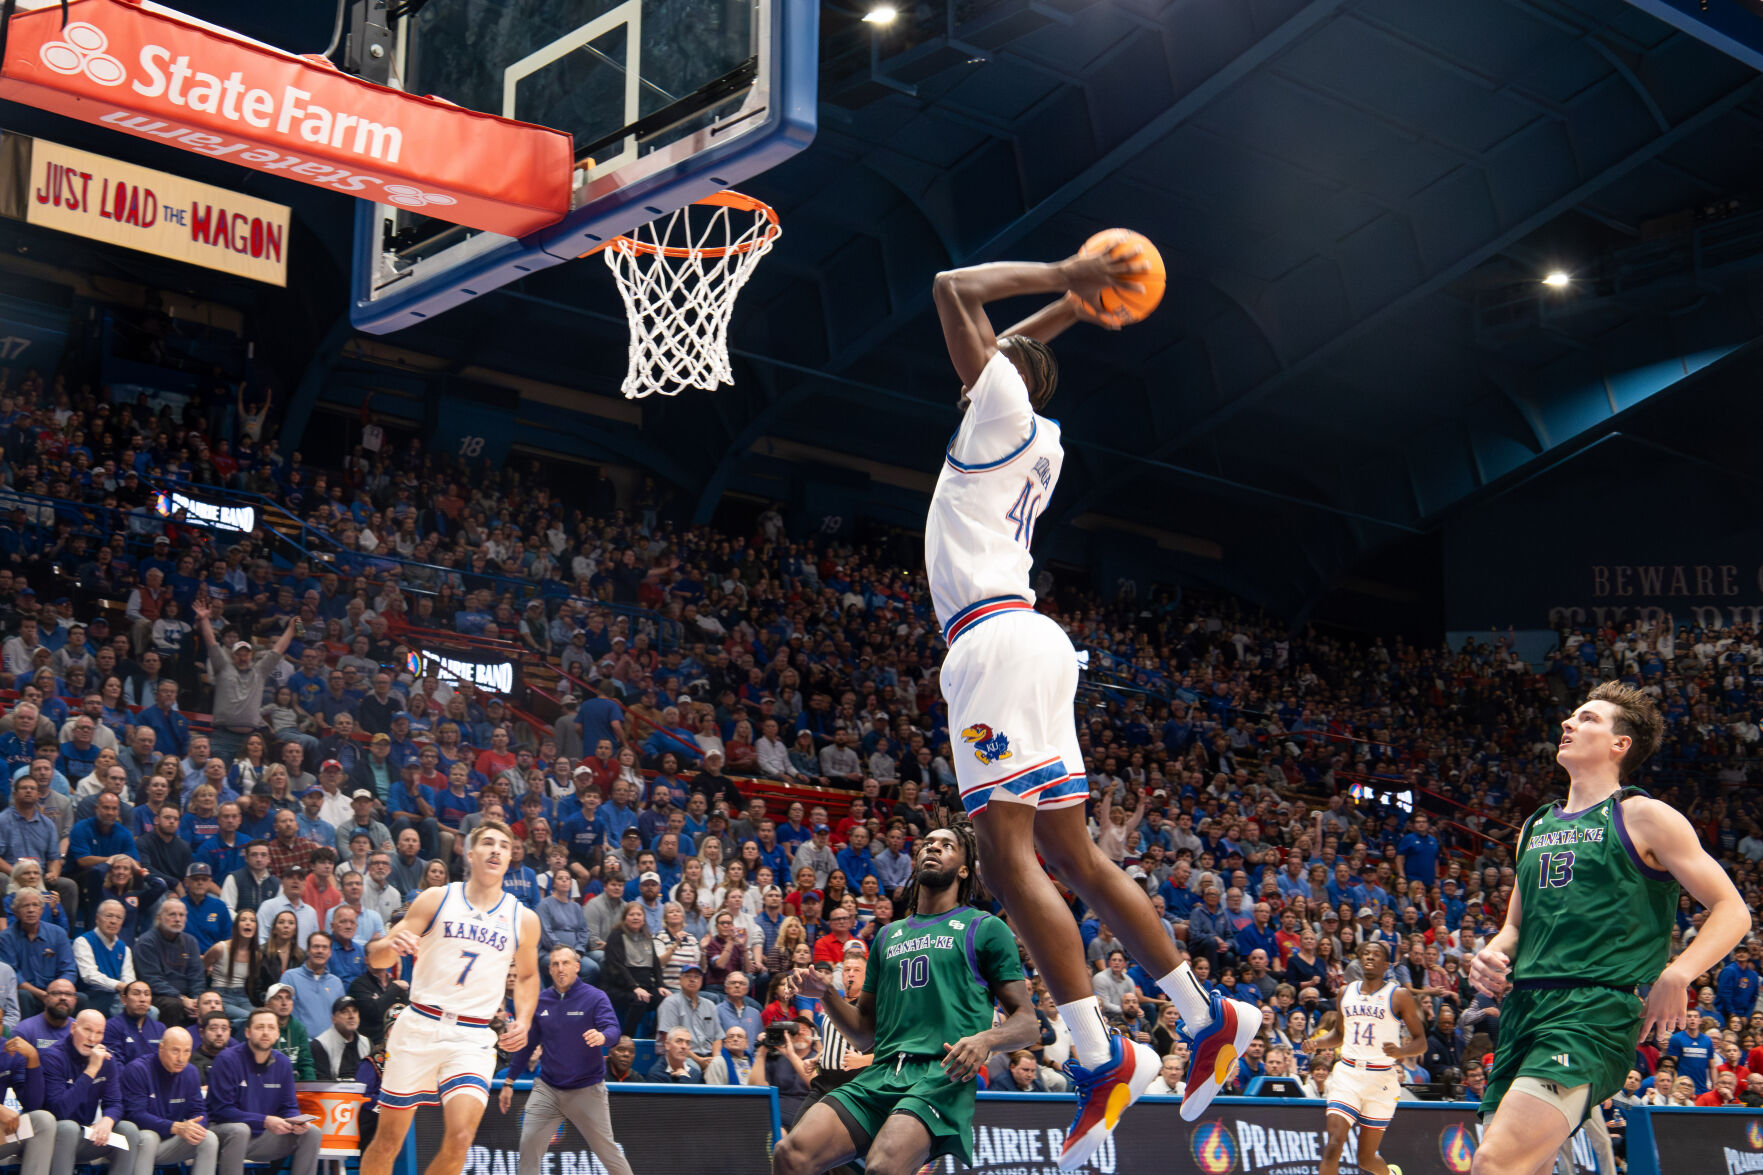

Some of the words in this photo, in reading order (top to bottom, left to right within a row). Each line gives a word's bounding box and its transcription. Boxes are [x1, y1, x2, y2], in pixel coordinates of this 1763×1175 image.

[37, 161, 93, 213] JUST
[99, 178, 158, 229] LOAD
[162, 205, 187, 227] THE
[191, 201, 282, 264] WAGON
[458, 435, 486, 457] 18
[818, 515, 843, 534] 19
[1592, 565, 1739, 597] BEWARE
[475, 662, 513, 694] BAND
[1538, 850, 1576, 889] 13
[443, 921, 507, 952] KANSAS
[456, 950, 480, 986] 7
[900, 954, 930, 991] 10
[1344, 1005, 1385, 1020] KANSAS
[1353, 1021, 1376, 1047] 14
[334, 1103, 353, 1123] G
[1236, 1120, 1323, 1172] PRAIRIE
